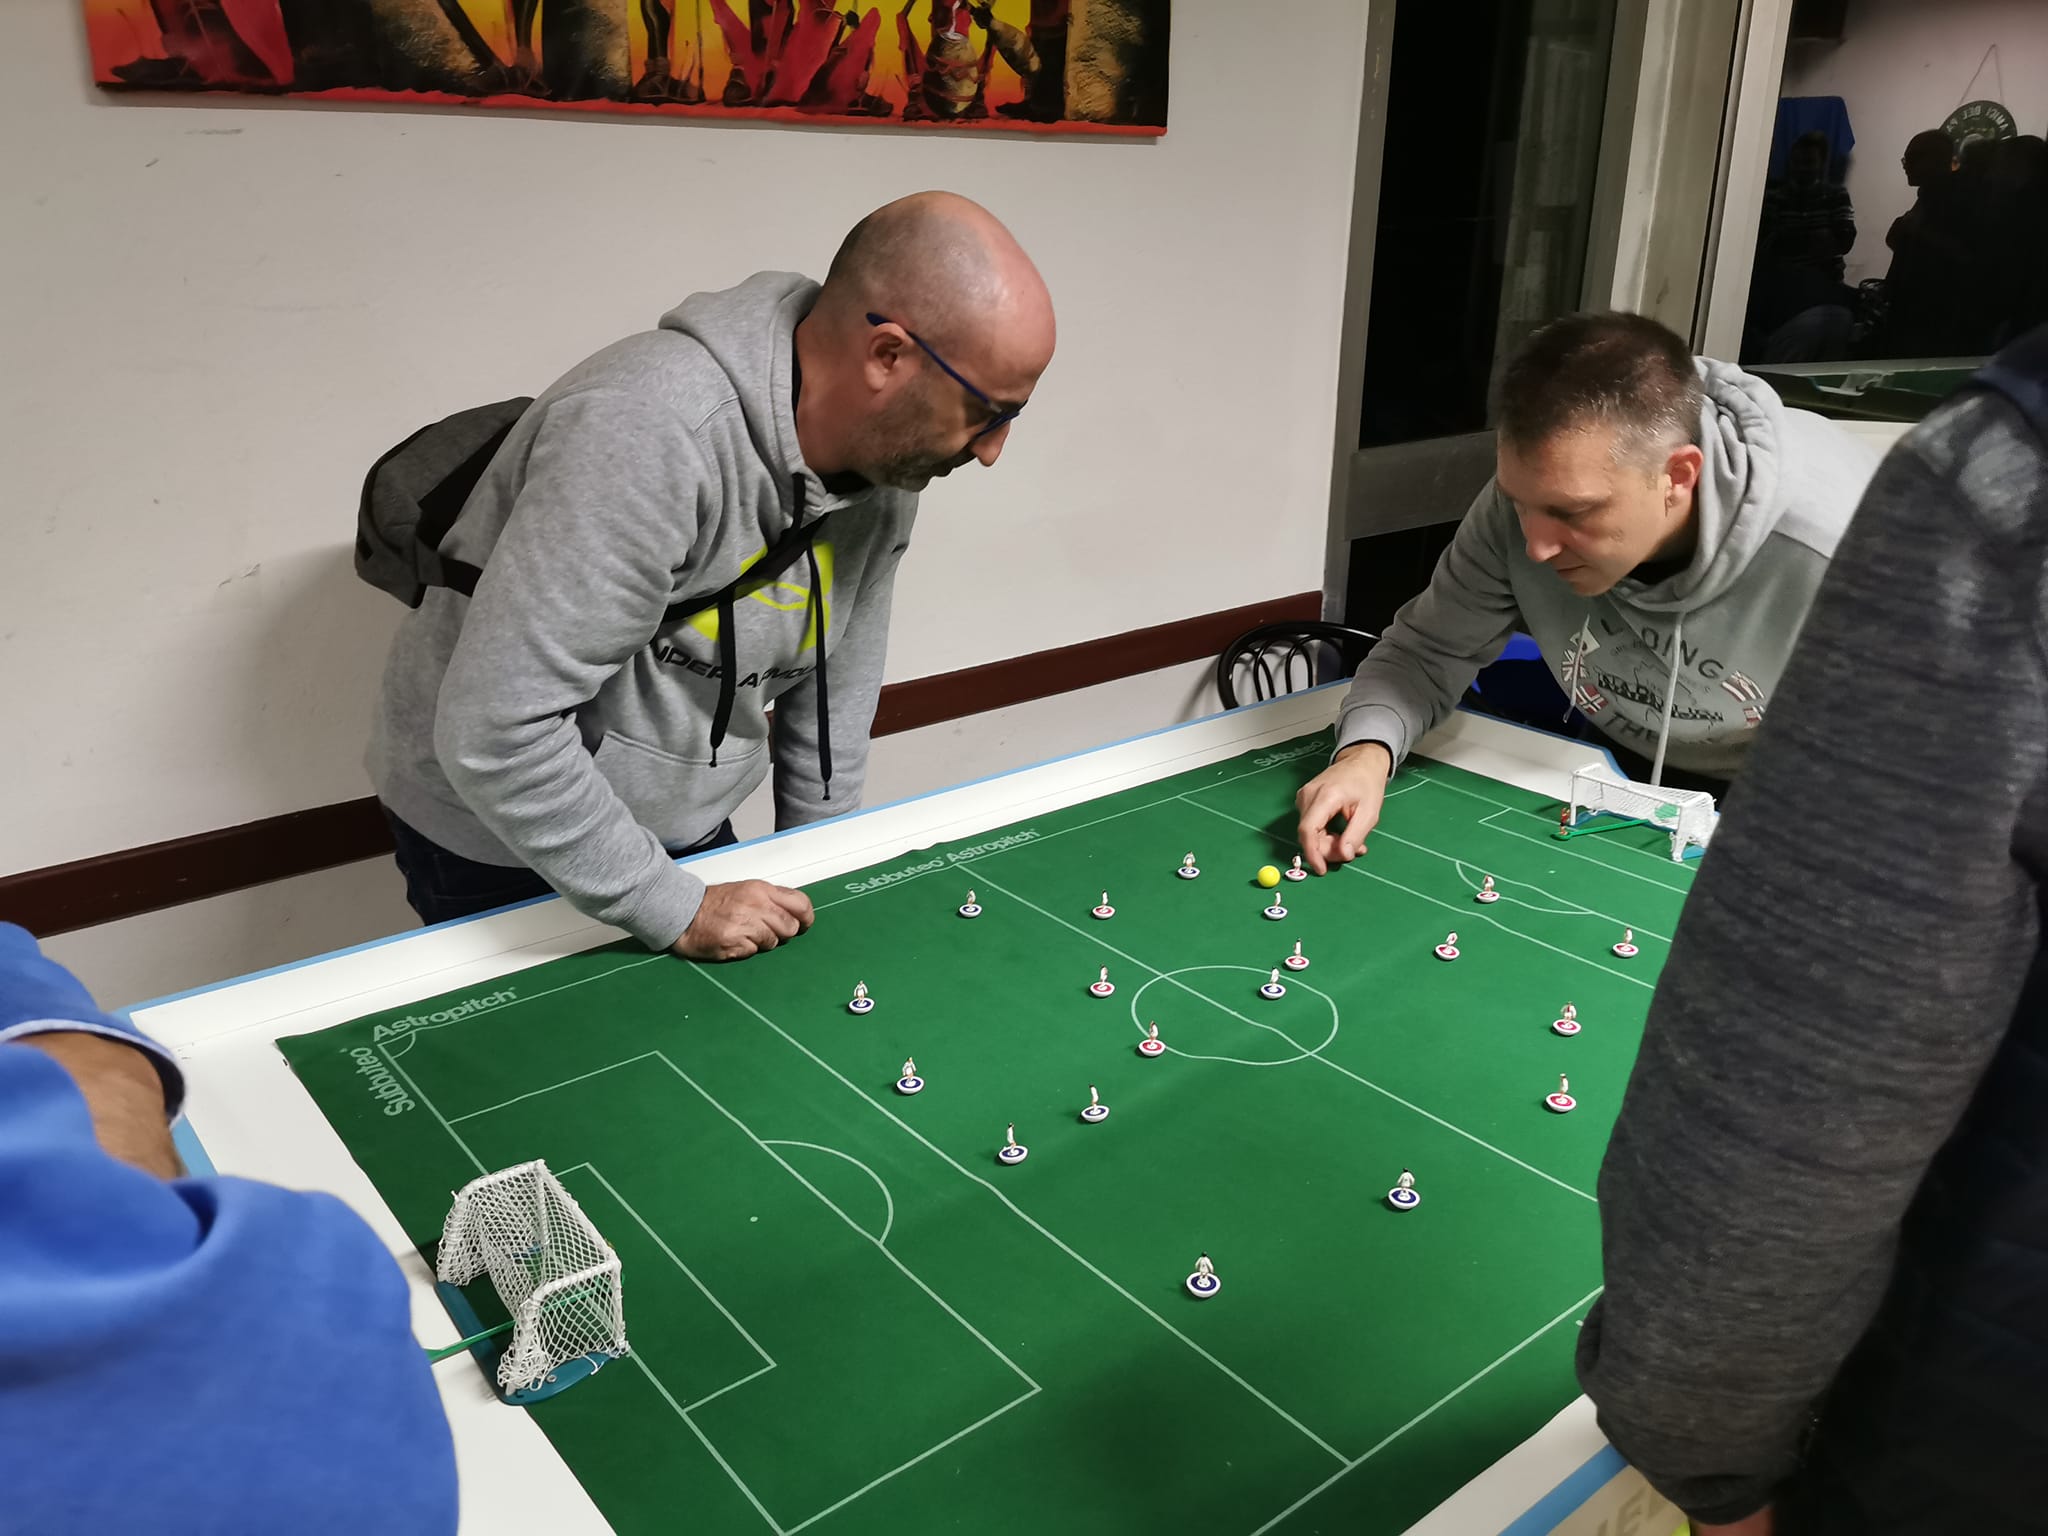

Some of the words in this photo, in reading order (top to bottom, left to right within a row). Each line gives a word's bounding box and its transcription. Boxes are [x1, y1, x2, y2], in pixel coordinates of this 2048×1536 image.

[653, 645, 723, 679] NDER
[844, 858, 944, 894] Subbuteo
[947, 829, 1040, 864] Astropitch
[373, 989, 518, 1042] Astropitch
[349, 1047, 416, 1117] Subbuteo
